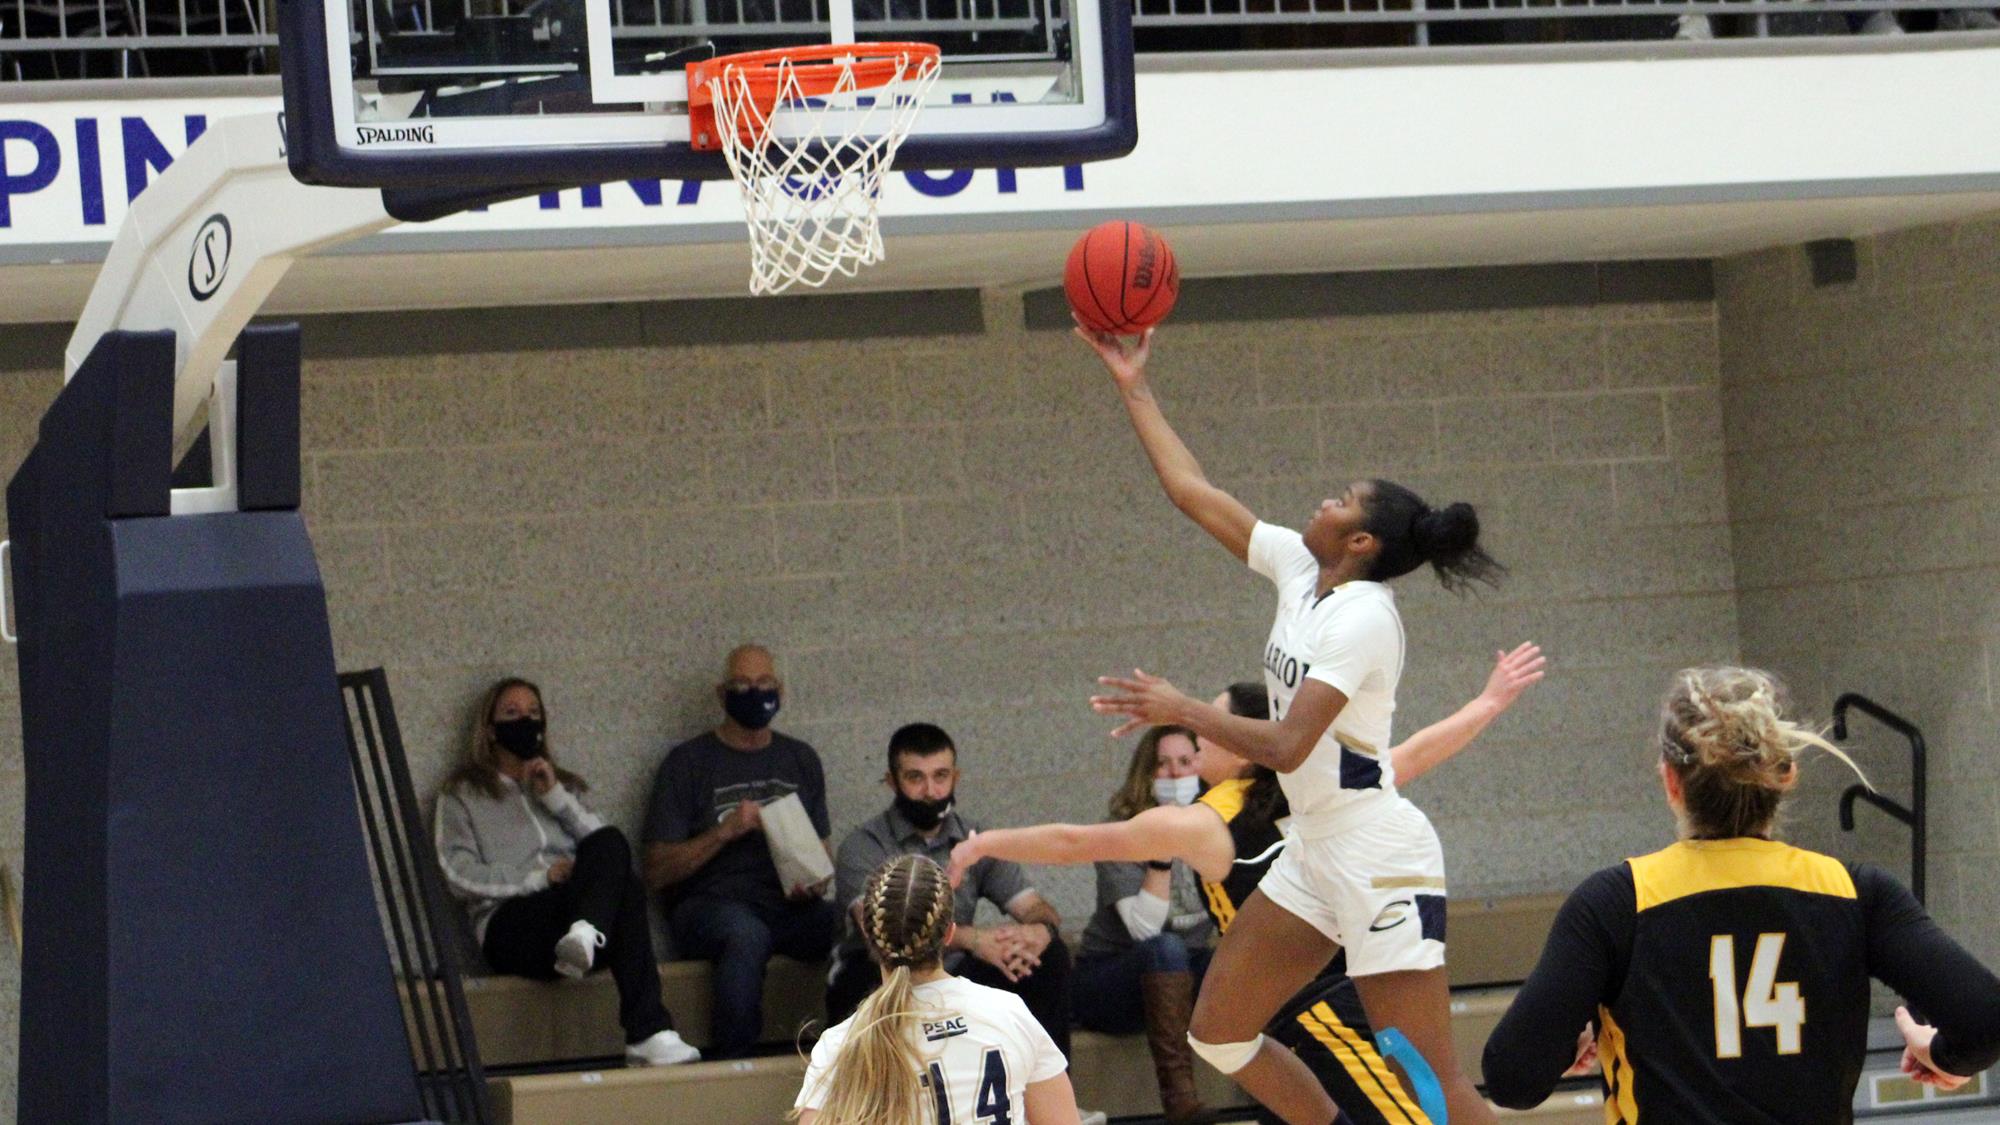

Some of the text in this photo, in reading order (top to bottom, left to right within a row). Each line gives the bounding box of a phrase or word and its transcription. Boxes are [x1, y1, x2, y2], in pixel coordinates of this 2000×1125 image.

[356, 125, 434, 145] SPALDING
[1709, 932, 1806, 1059] 14
[922, 1016, 967, 1035] PSAC
[919, 1048, 1012, 1125] 14
